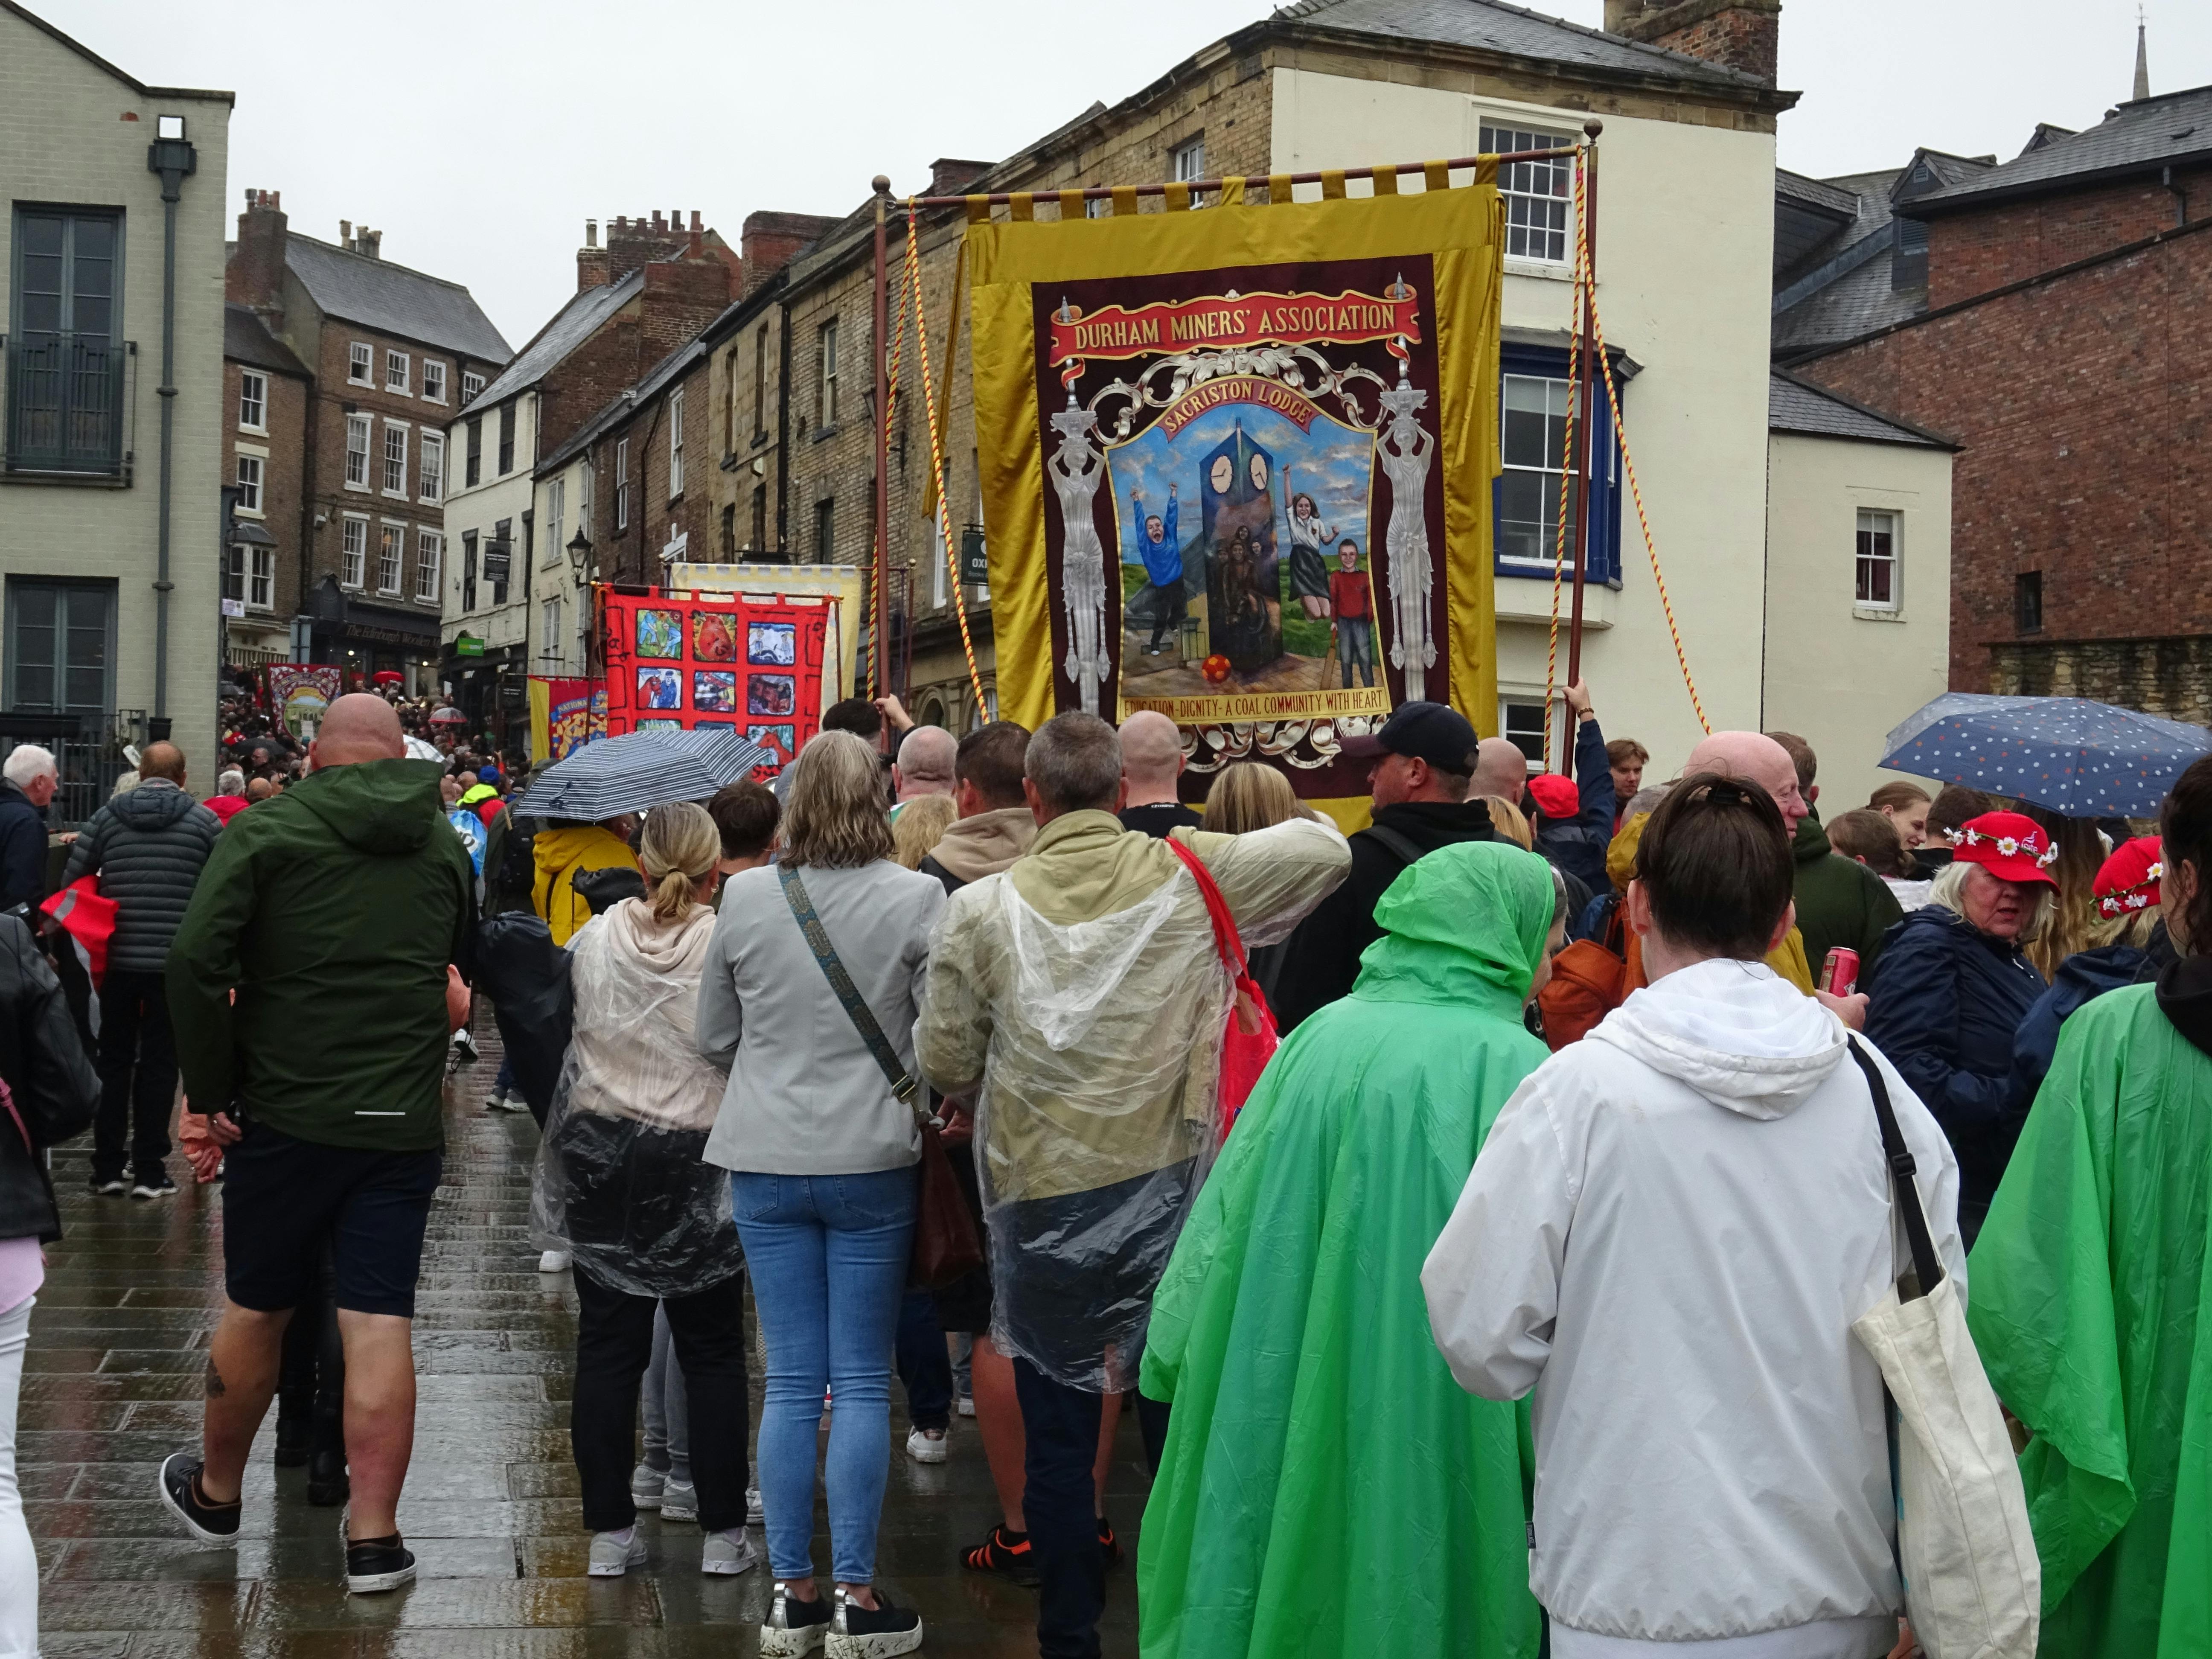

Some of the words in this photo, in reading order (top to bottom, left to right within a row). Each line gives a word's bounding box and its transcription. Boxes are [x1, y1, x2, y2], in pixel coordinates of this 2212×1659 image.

[1074, 318, 1159, 349] DURHAM
[1170, 309, 1251, 341] MINERS'
[1257, 305, 1394, 334] ASSOCIATION
[1164, 381, 1252, 432] SACRISTON
[1258, 384, 1312, 423] LODGE
[558, 699, 588, 713] NATIONA
[1225, 699, 1232, 716] A
[1236, 697, 1261, 715] COAL
[1264, 693, 1321, 714] COMMUNITY
[1326, 692, 1350, 710] WITH
[1353, 690, 1382, 709] HEART
